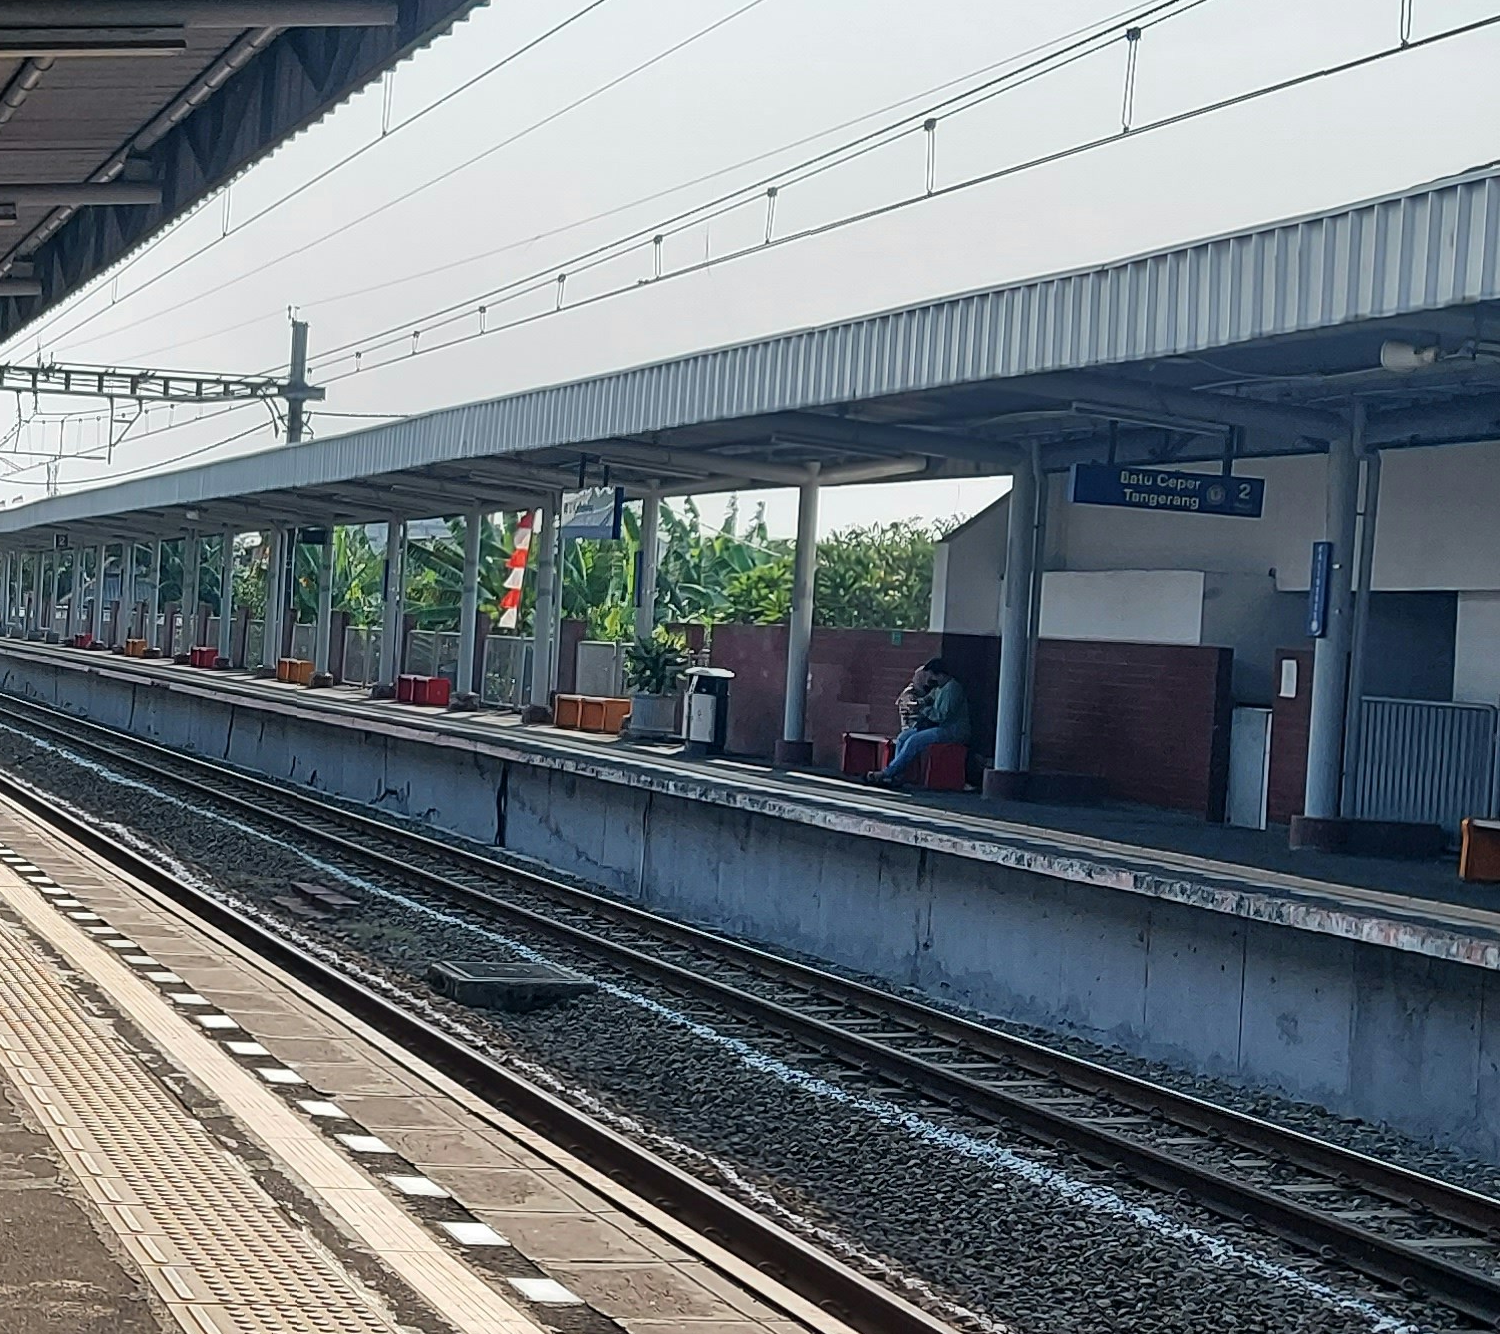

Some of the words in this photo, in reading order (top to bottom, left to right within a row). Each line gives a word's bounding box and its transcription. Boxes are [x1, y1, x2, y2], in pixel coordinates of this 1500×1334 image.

[1121, 470, 1152, 485] Batu
[1157, 473, 1201, 491] Ceper
[1239, 483, 1252, 499] 2
[1124, 488, 1199, 510] Tangerang
